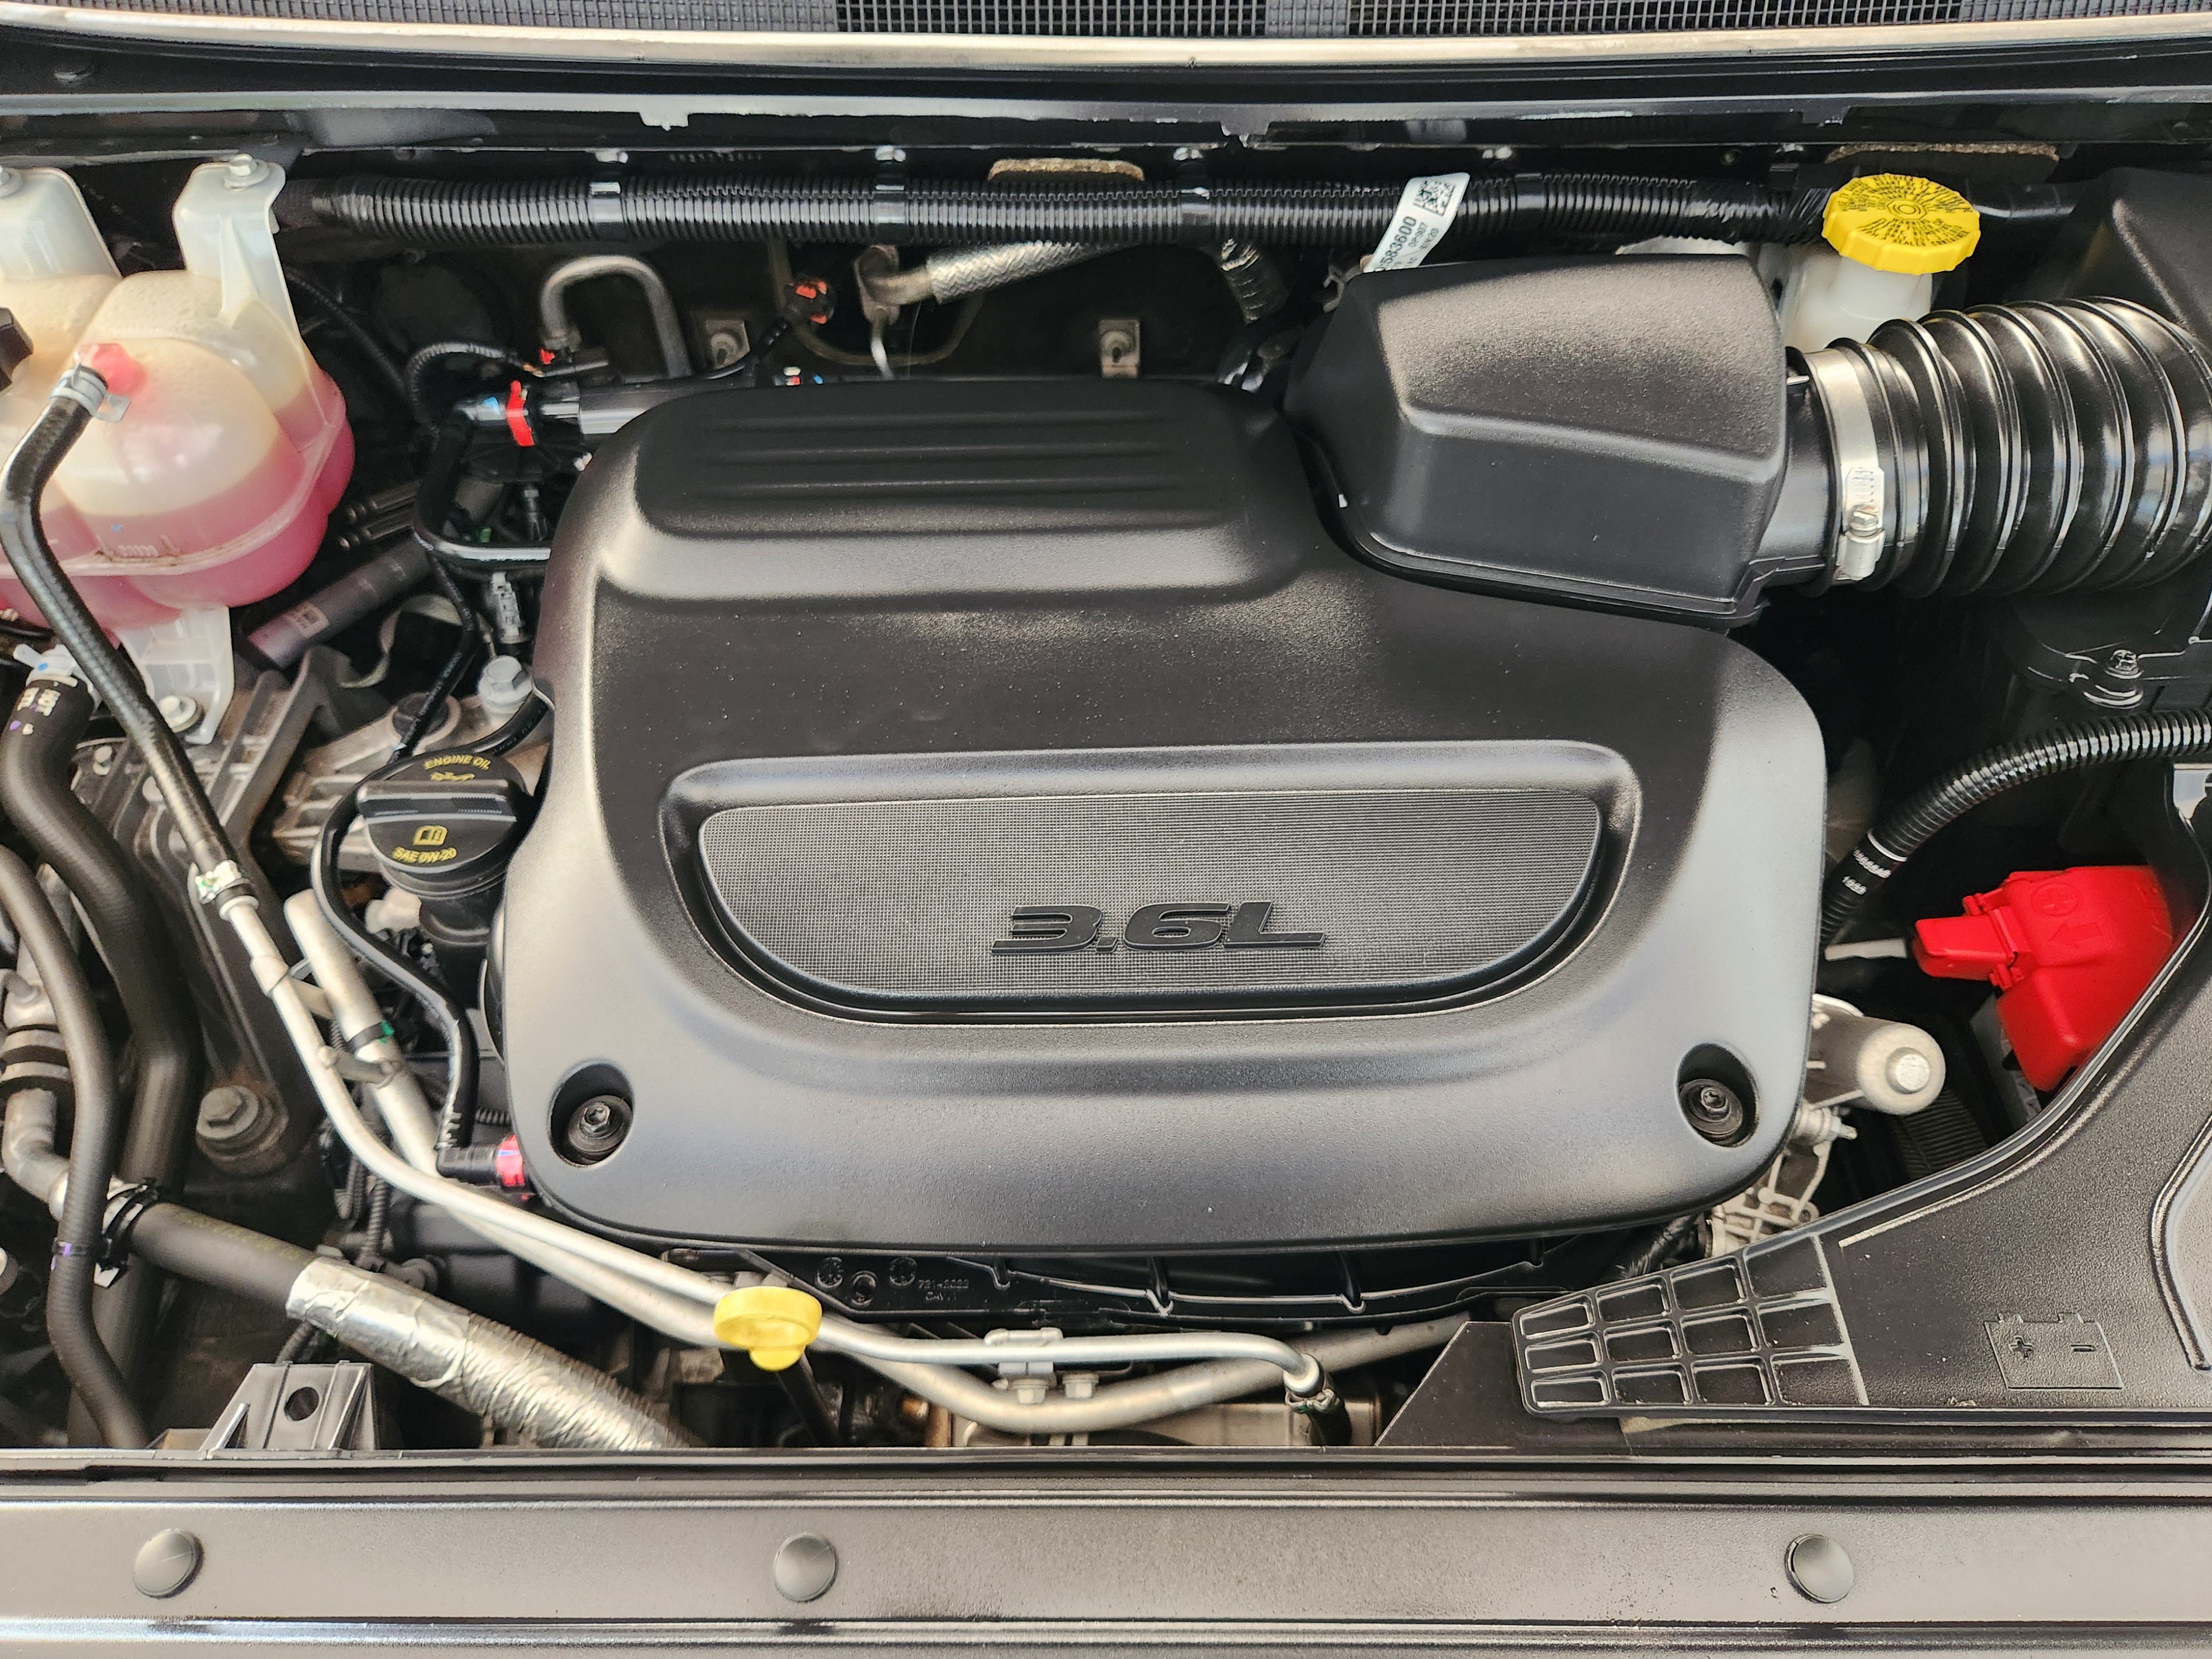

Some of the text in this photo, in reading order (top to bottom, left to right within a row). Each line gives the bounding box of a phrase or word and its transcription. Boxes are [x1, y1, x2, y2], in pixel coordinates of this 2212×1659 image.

[424, 754, 492, 770] ENGINE OIL
[392, 846, 420, 863] SAE
[991, 900, 1326, 954] 3.6L
